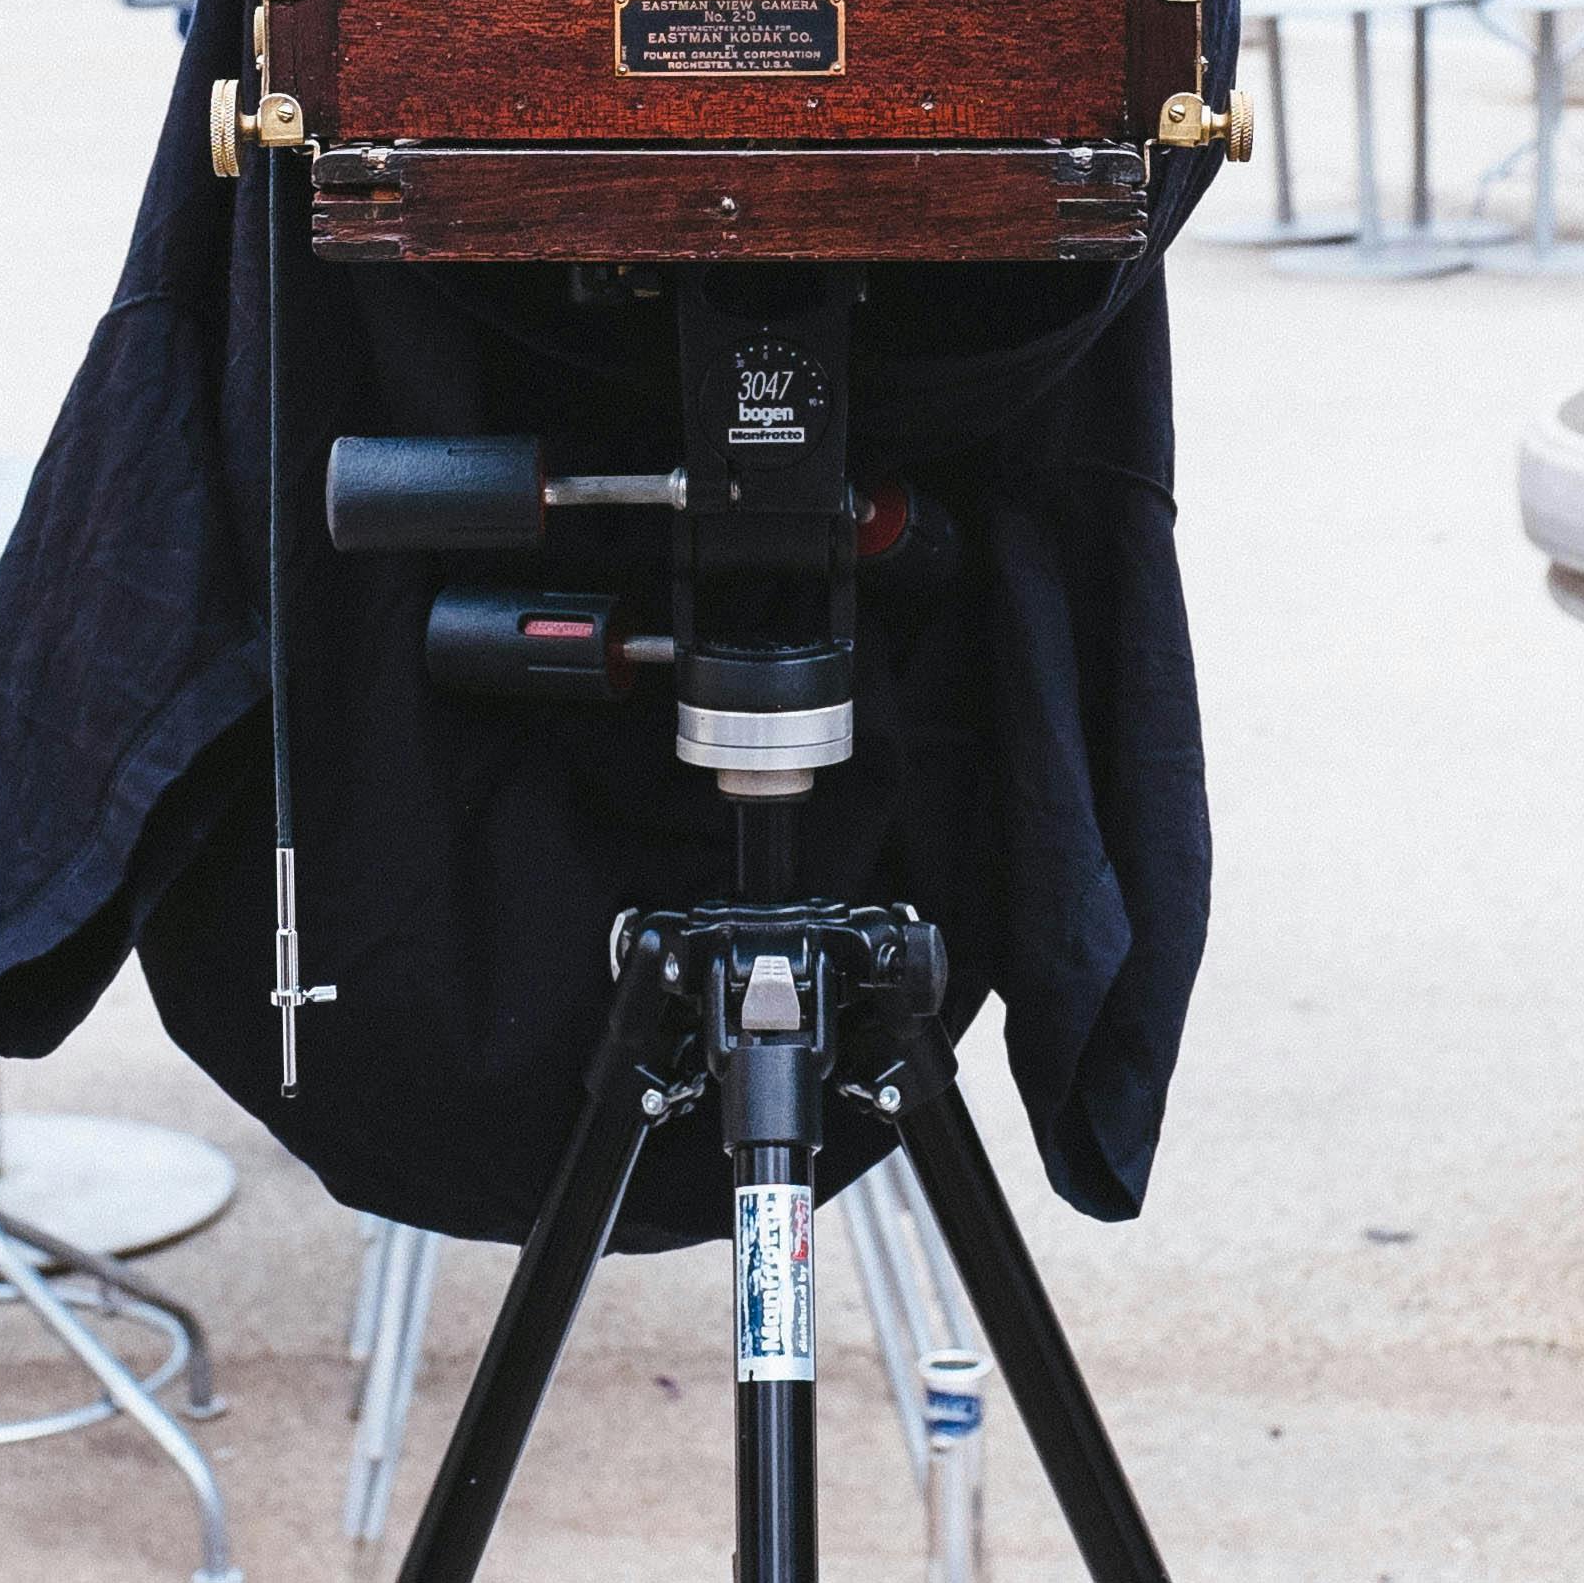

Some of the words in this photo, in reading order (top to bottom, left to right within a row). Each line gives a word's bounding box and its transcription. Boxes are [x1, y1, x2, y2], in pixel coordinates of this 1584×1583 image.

[641, 0, 708, 11] EASTMAN
[717, 0, 753, 11] VIEW
[761, 0, 818, 11] CAMERA
[704, 11, 726, 23] No.
[648, 32, 722, 44] EASTMAN
[730, 32, 782, 44] KODAK
[789, 32, 813, 43] CO.
[643, 51, 686, 60] FOLMER
[691, 51, 738, 60] GRAFLEX
[744, 51, 821, 60] CORPORATION
[737, 371, 794, 401] 3047
[738, 403, 794, 427] bogen
[731, 430, 803, 441] Manfrotto
